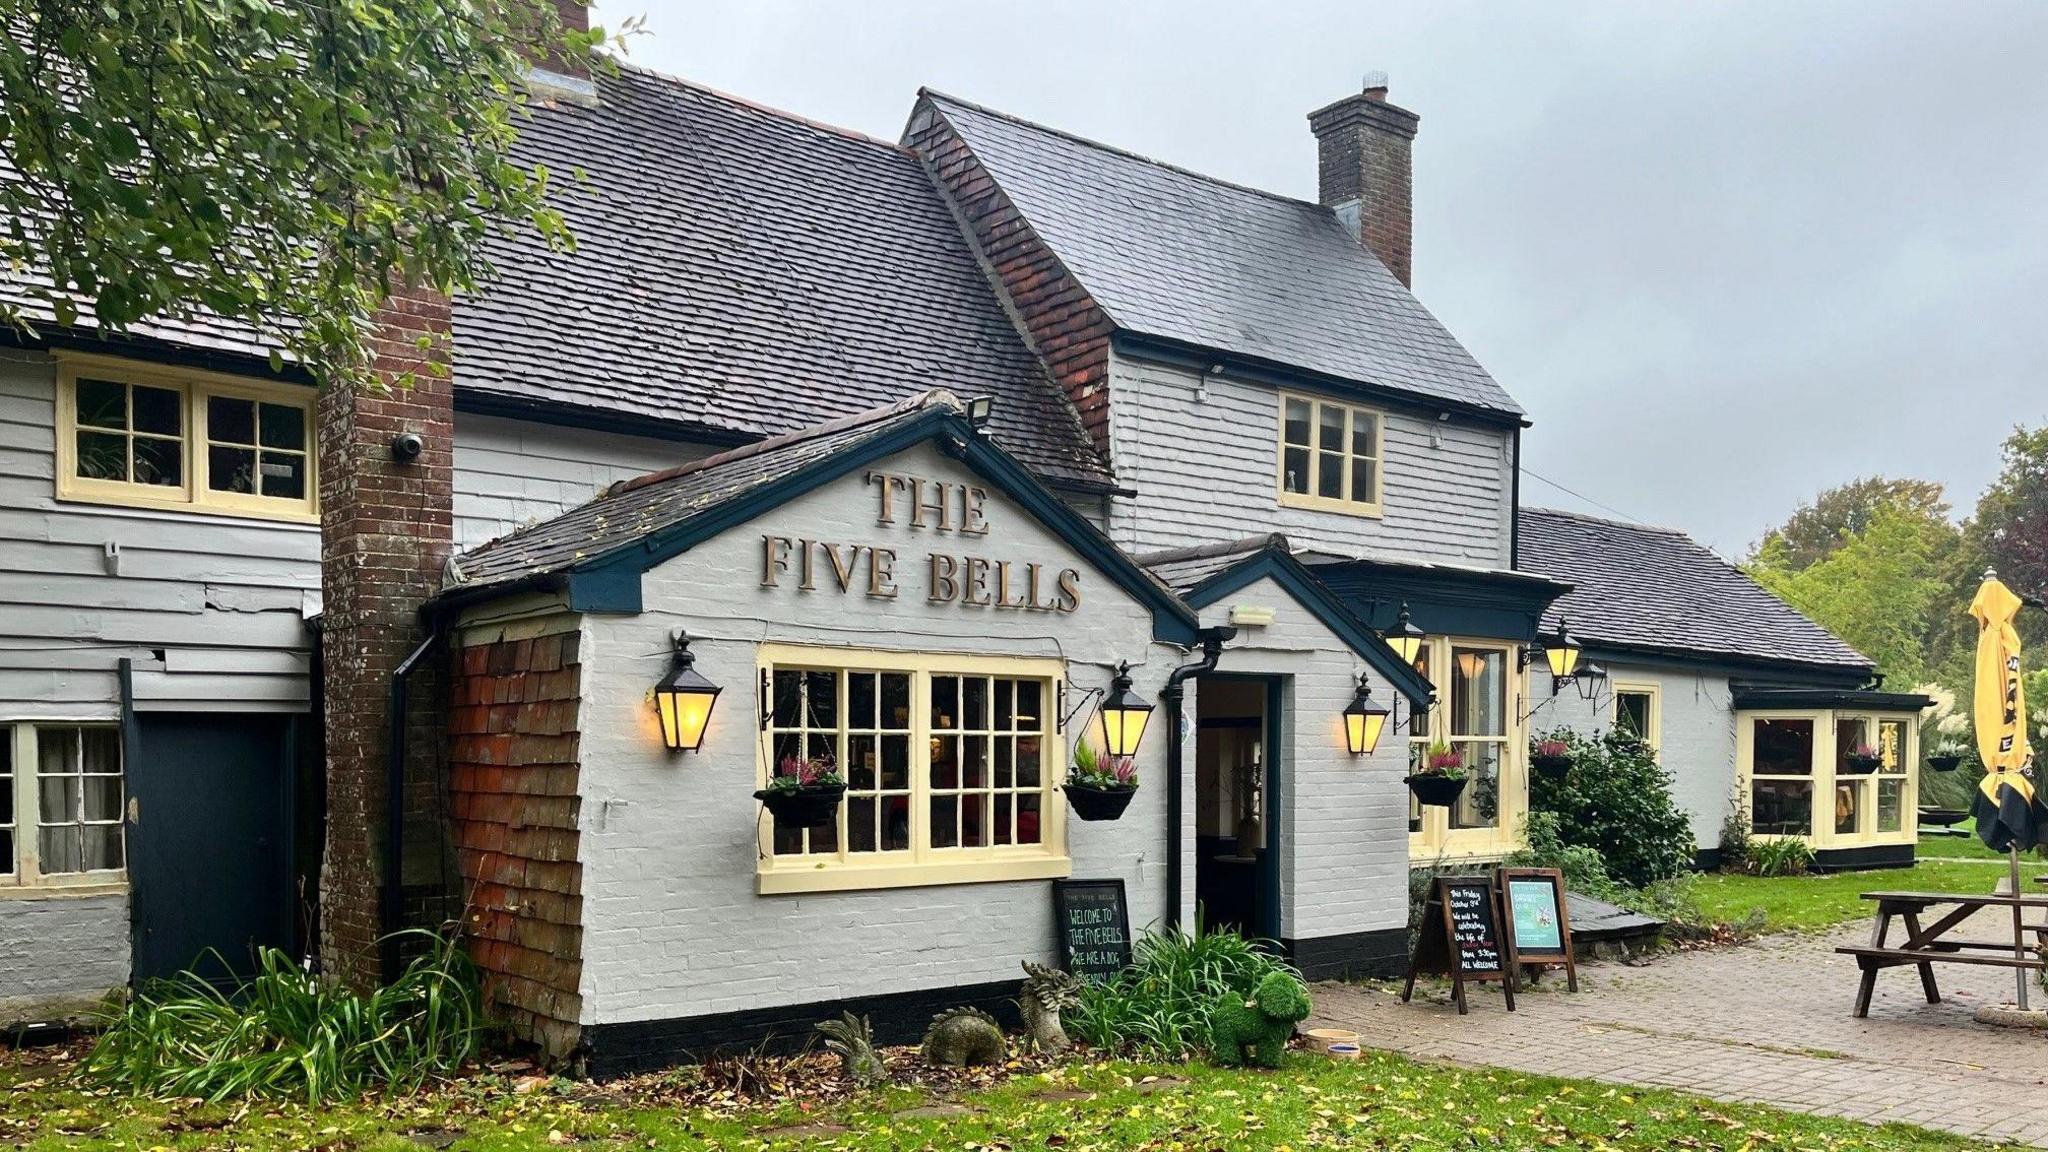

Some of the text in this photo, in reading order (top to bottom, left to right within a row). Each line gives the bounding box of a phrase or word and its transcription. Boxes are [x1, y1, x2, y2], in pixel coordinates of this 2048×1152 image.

[866, 471, 989, 535] THE
[760, 534, 1081, 613] FIVE BELLS
[1462, 889, 1481, 901] Friday
[1450, 900, 1469, 908] October
[1069, 907, 1112, 925] WELCOME TO
[1461, 912, 1471, 920] will
[1471, 912, 1480, 920] be
[1458, 921, 1486, 933] celebrating
[1069, 927, 1123, 945] THE FIVE BELLS
[1466, 932, 1475, 943] life
[1477, 933, 1485, 943] of
[1086, 951, 1099, 965] ARE
[1100, 951, 1106, 965] A
[1461, 959, 1499, 970] ALL WELCOME
